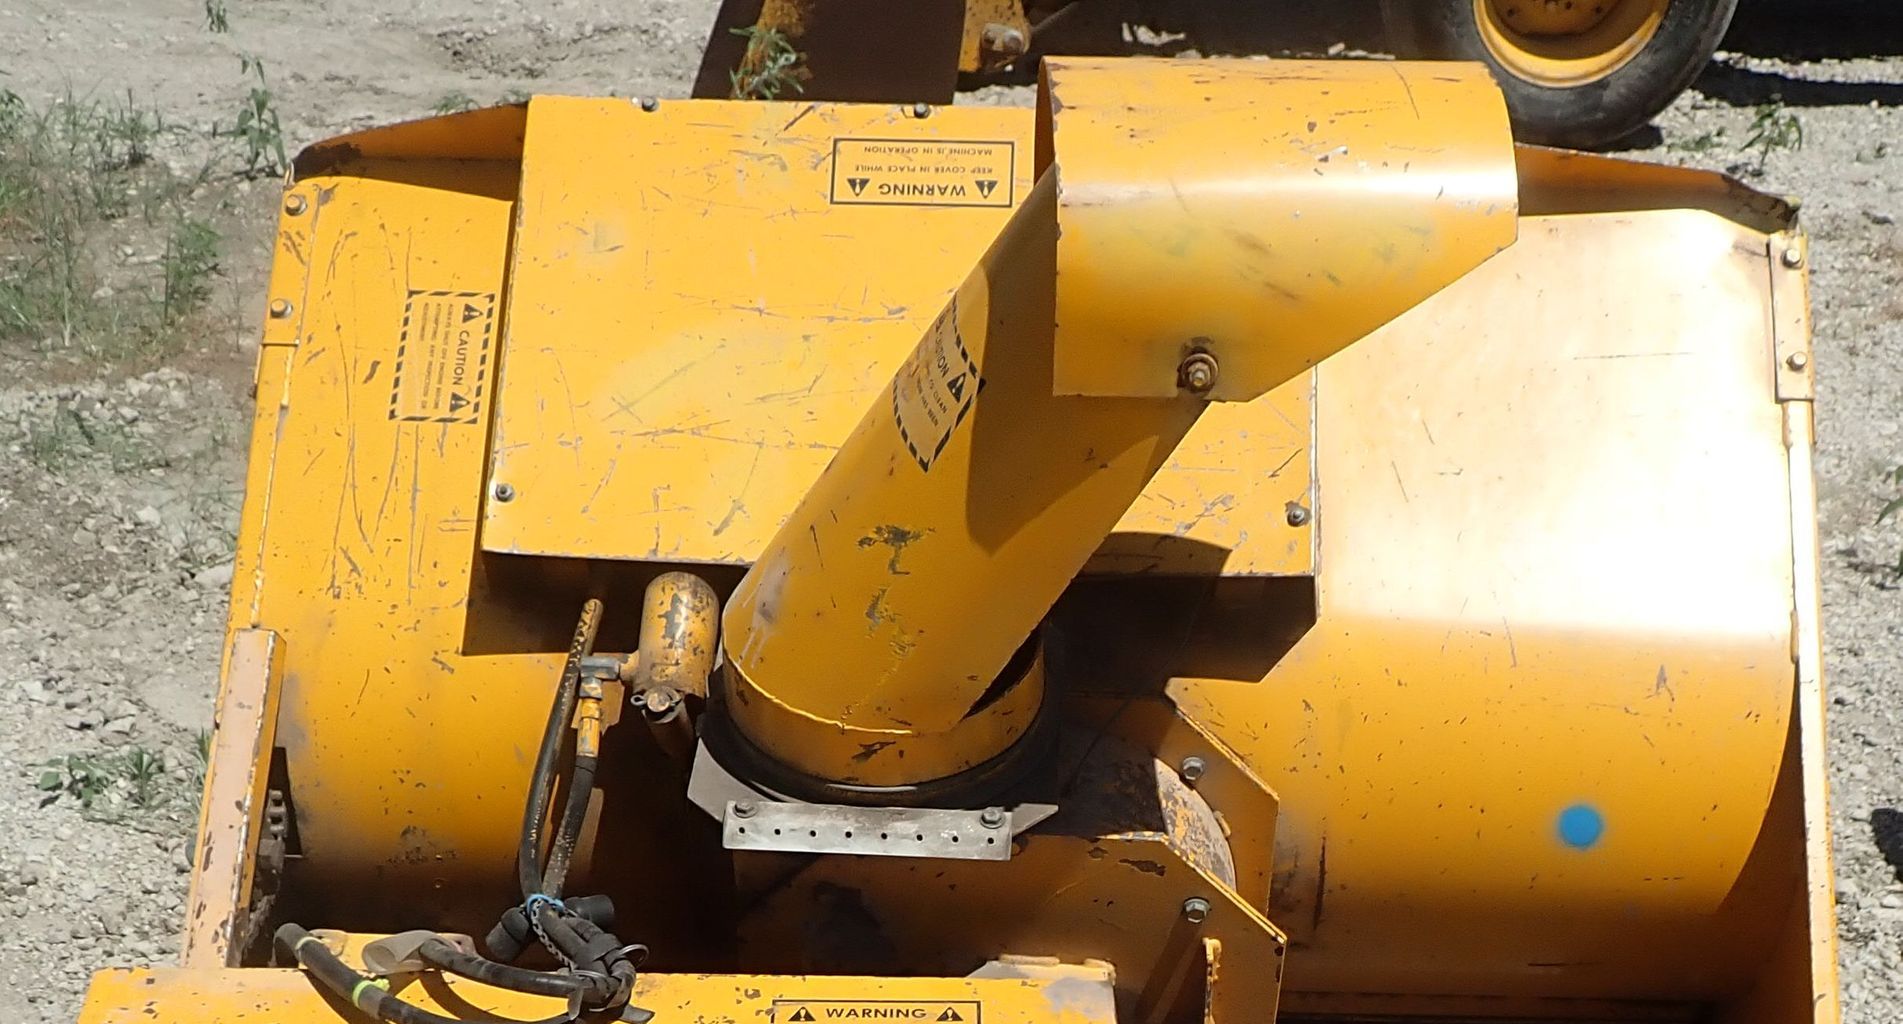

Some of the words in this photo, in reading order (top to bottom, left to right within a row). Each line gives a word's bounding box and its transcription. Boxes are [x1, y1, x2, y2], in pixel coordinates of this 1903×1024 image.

[864, 146, 918, 154] OPERATION
[922, 146, 933, 154] IN
[949, 147, 993, 156] MACHINE
[855, 164, 883, 172] WHILE
[935, 166, 965, 174] COVER
[878, 183, 966, 197] WARNING
[452, 330, 470, 385] CAUTION
[935, 331, 950, 378] TION
[826, 1008, 927, 1019] WARNING
